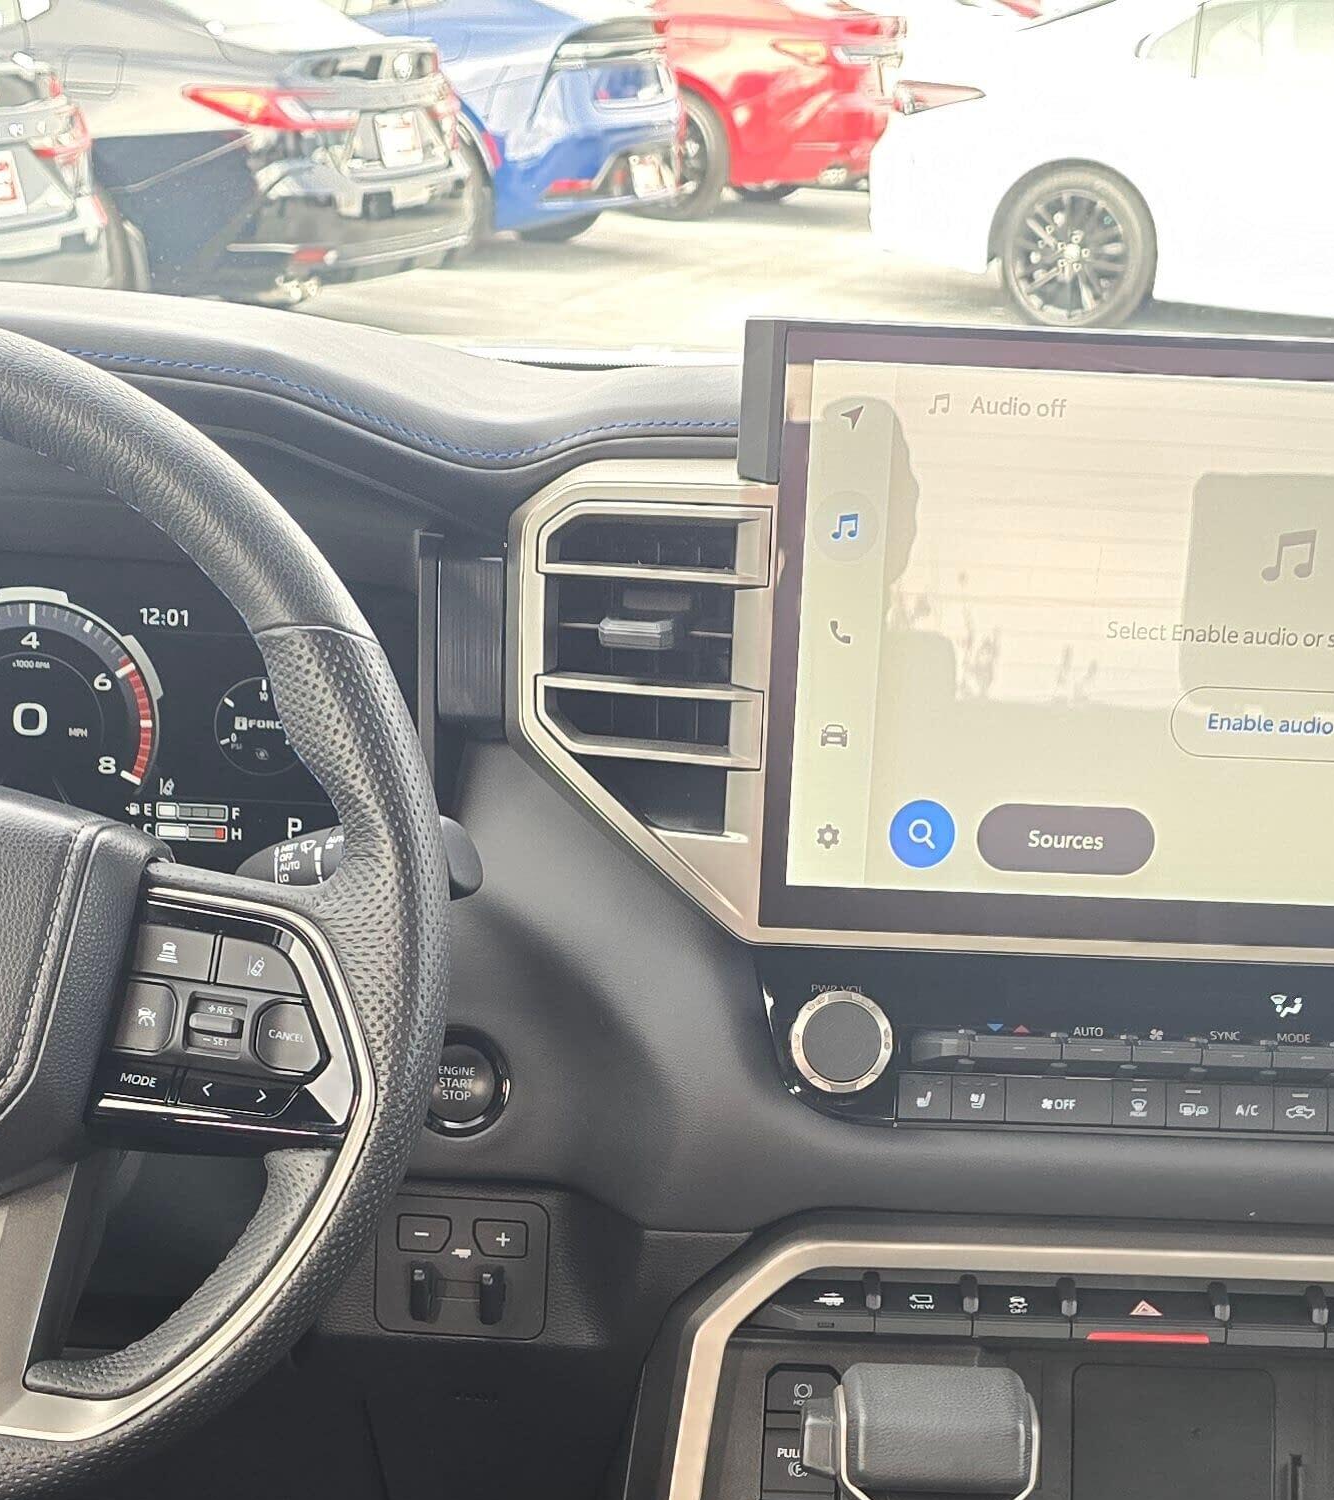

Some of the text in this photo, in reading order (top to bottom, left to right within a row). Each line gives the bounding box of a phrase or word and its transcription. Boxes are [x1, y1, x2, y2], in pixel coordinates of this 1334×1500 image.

[970, 395, 1067, 419] Audio off
[139, 607, 189, 627] 12:01
[20, 631, 40, 649] 4
[1107, 620, 1165, 644] Select
[1172, 621, 1237, 646] Enable
[1243, 624, 1296, 648] audio
[1301, 632, 1321, 649] or
[93, 673, 112, 691] 6
[13, 702, 48, 736] 0
[1207, 711, 1334, 737] Enable audio
[68, 727, 88, 737] MPH
[98, 756, 116, 774] 8
[143, 803, 240, 821] E F
[231, 827, 242, 841] H
[287, 817, 302, 839] P
[1027, 827, 1104, 853] Sources
[280, 852, 294, 862] OFF
[280, 861, 300, 871] AUTO
[268, 1028, 305, 1044] CANCEL
[1073, 1026, 1104, 1037] AUTO
[1210, 1030, 1240, 1041] SYNC
[1277, 1033, 1311, 1044] MODE
[438, 1065, 476, 1077] ENGINE
[120, 1071, 157, 1089] MODE
[439, 1077, 474, 1089] START
[442, 1089, 472, 1101] STOP
[1054, 1098, 1076, 1111] OFF
[1235, 1104, 1259, 1117] A/C
